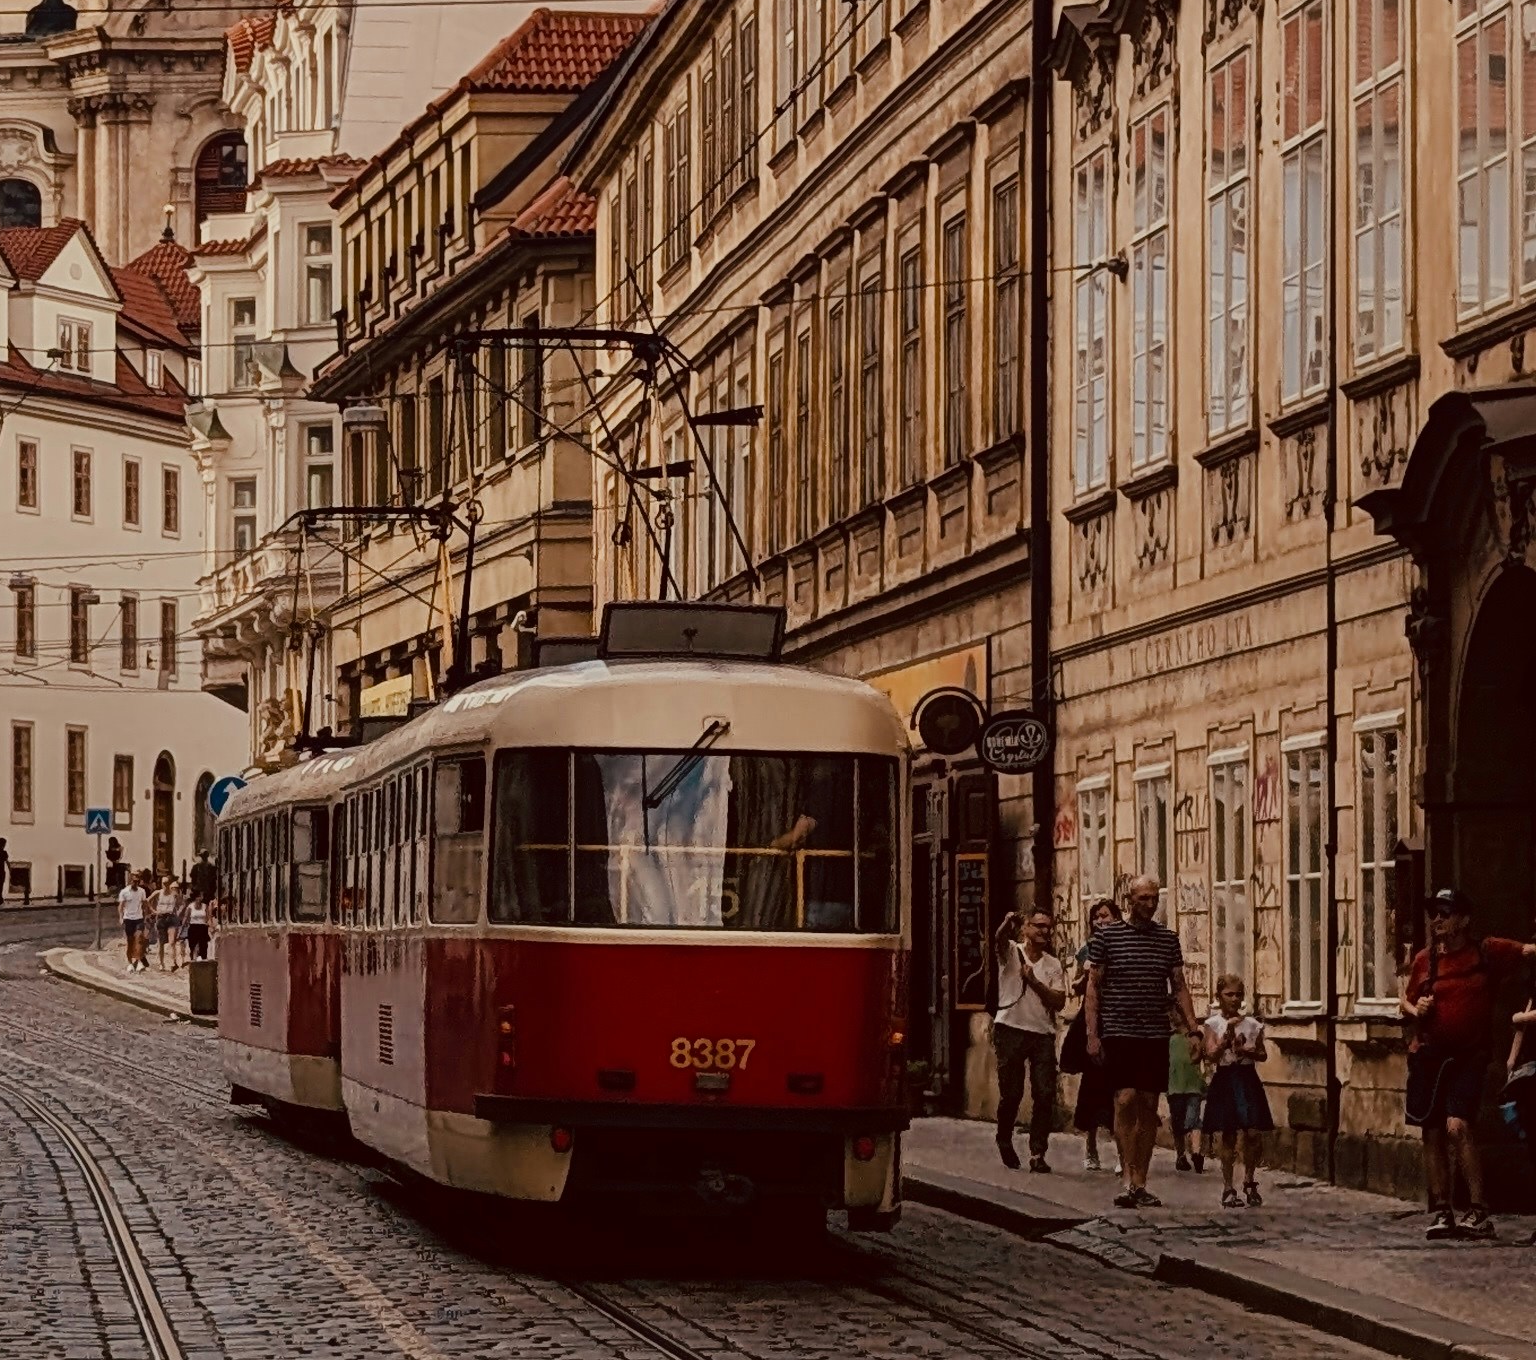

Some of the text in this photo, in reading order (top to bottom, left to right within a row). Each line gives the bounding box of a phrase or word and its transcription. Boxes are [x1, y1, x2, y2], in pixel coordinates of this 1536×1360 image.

[1225, 613, 1253, 651] LVA
[688, 873, 740, 920] 15
[670, 1037, 756, 1070] 8387
